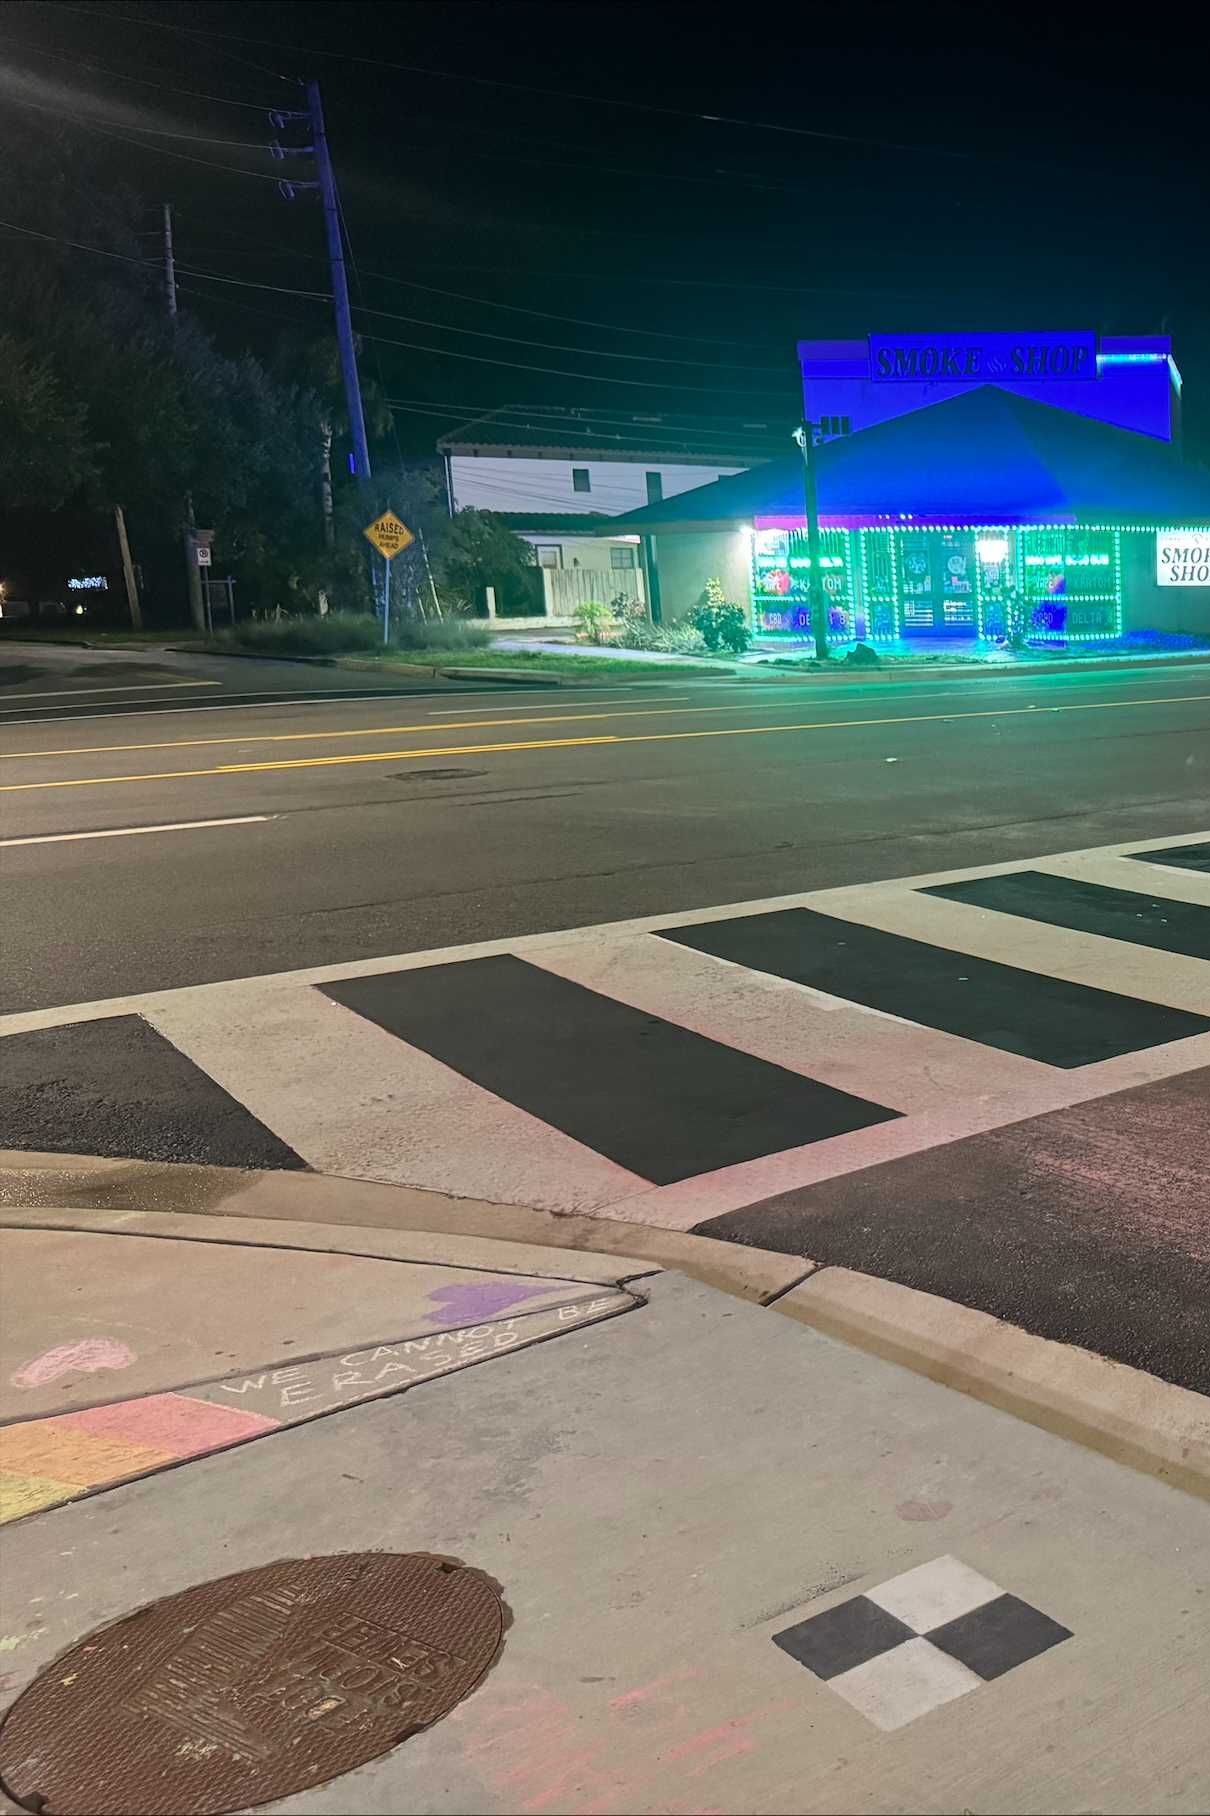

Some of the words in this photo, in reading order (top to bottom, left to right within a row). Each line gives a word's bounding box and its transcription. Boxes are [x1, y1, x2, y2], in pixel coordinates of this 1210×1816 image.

[877, 347, 983, 376] SMOKE
[1010, 344, 1088, 374] SHOP
[374, 521, 405, 535] RAISED
[1072, 612, 1102, 624] DELTA
[221, 1366, 312, 1394] WE
[340, 1318, 524, 1368] CANNOT
[558, 1298, 616, 1321] BE
[279, 1331, 518, 1407] ERASED
